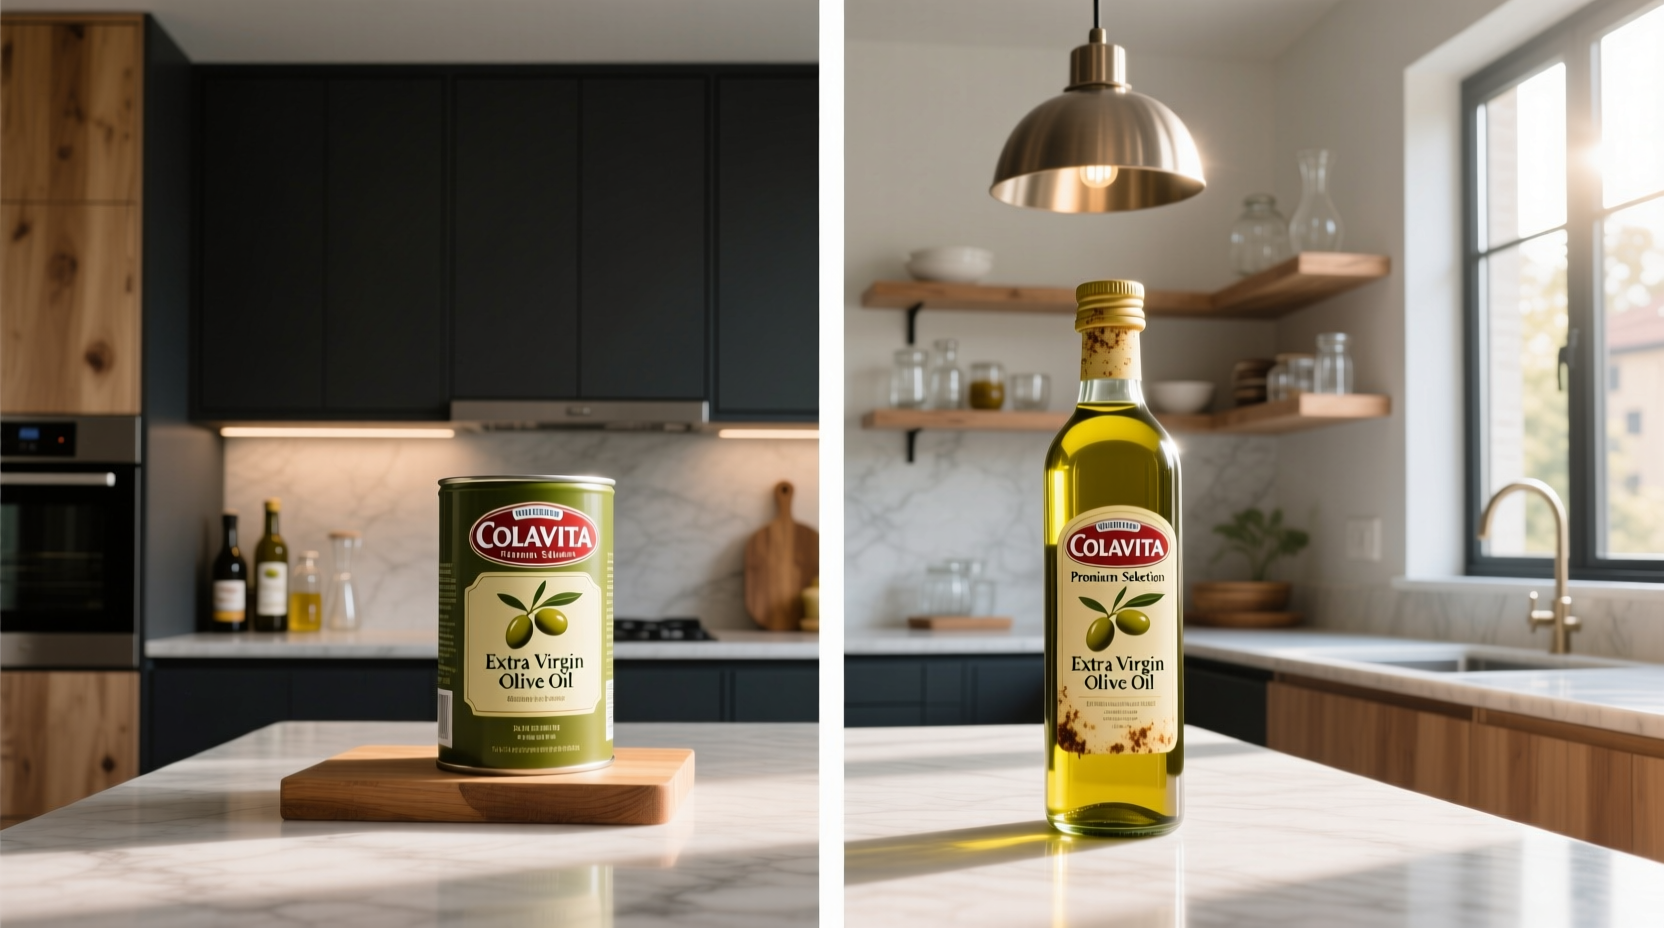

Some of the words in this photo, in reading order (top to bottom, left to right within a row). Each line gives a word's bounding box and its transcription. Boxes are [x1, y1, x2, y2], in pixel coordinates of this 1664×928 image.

[476, 521, 592, 549] COLAVITA
[1070, 533, 1164, 557] COLAVITA
[486, 653, 530, 670] Extra
[534, 653, 584, 675] Virgin
[1071, 656, 1113, 671] Extra
[1116, 656, 1164, 676] Virgin
[498, 672, 545, 689] Olive
[548, 672, 574, 689] Oil
[1084, 674, 1127, 690] Olive
[1131, 674, 1154, 690] Oil
